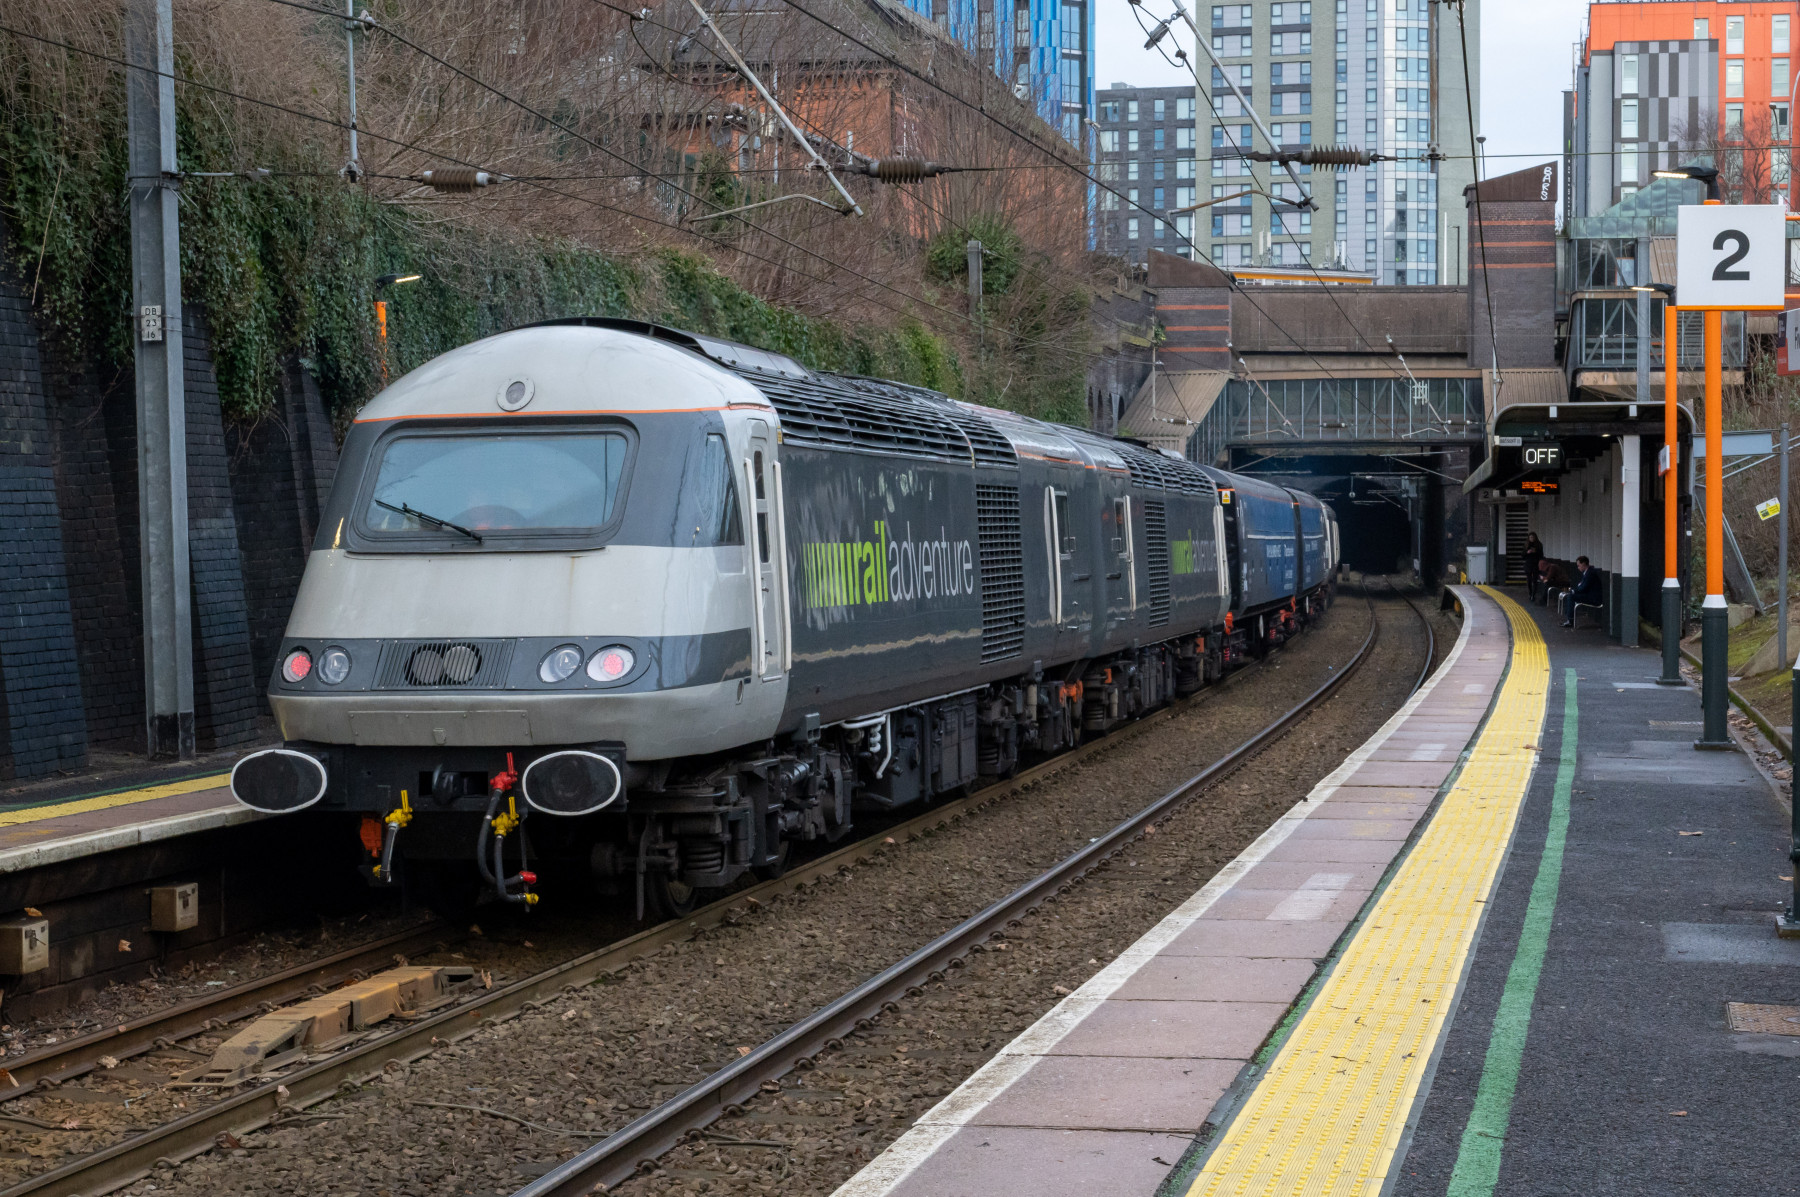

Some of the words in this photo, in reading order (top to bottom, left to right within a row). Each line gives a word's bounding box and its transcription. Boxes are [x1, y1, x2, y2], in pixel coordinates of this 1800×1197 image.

[1712, 229, 1750, 281] 2
[146, 319, 157, 327] 23
[147, 331, 156, 339] 16
[1525, 448, 1559, 464] OFF
[1483, 491, 1489, 499] 2
[853, 520, 973, 605] railadventure
